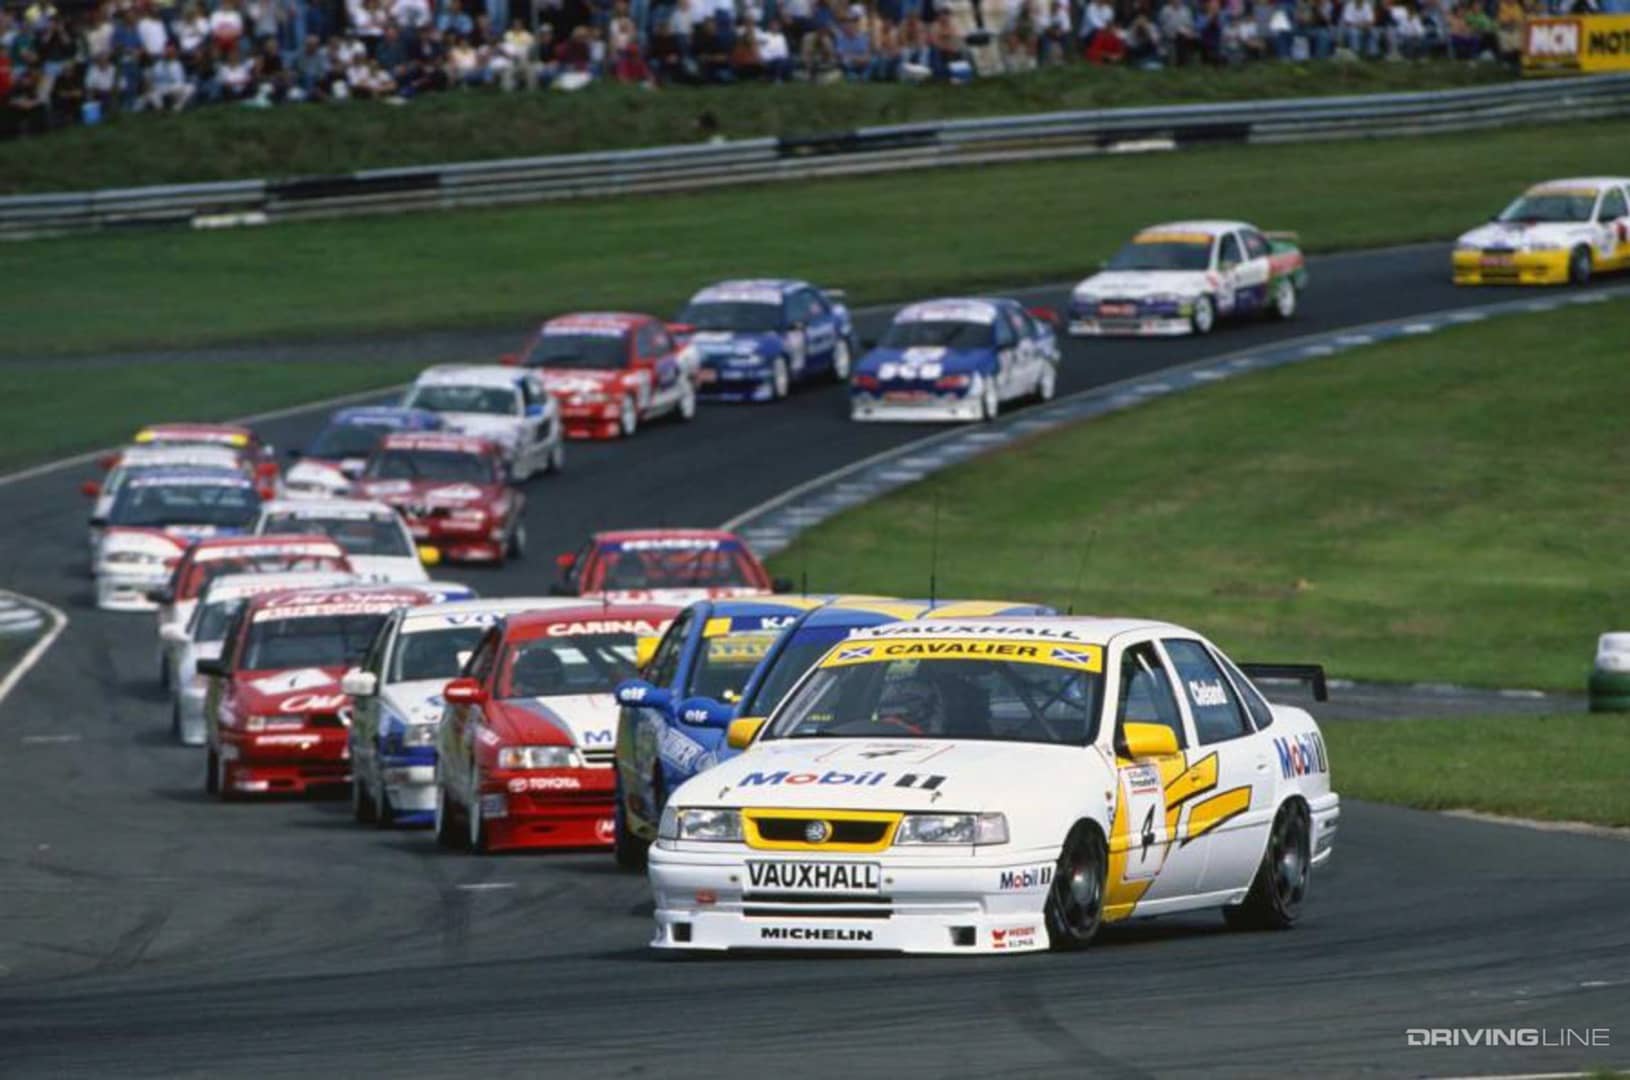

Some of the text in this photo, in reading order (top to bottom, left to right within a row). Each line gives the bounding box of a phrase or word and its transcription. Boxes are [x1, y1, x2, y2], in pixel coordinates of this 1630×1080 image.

[547, 619, 656, 636] CARINA
[885, 643, 1039, 657] CAVALIER
[620, 685, 648, 700] elf
[529, 777, 581, 789] TOYOTA
[738, 771, 887, 787] Mobil
[1140, 802, 1156, 864] 4
[749, 864, 879, 889] VAUXHALL
[1000, 869, 1038, 889] Mobil
[761, 927, 873, 941] MICHELIN
